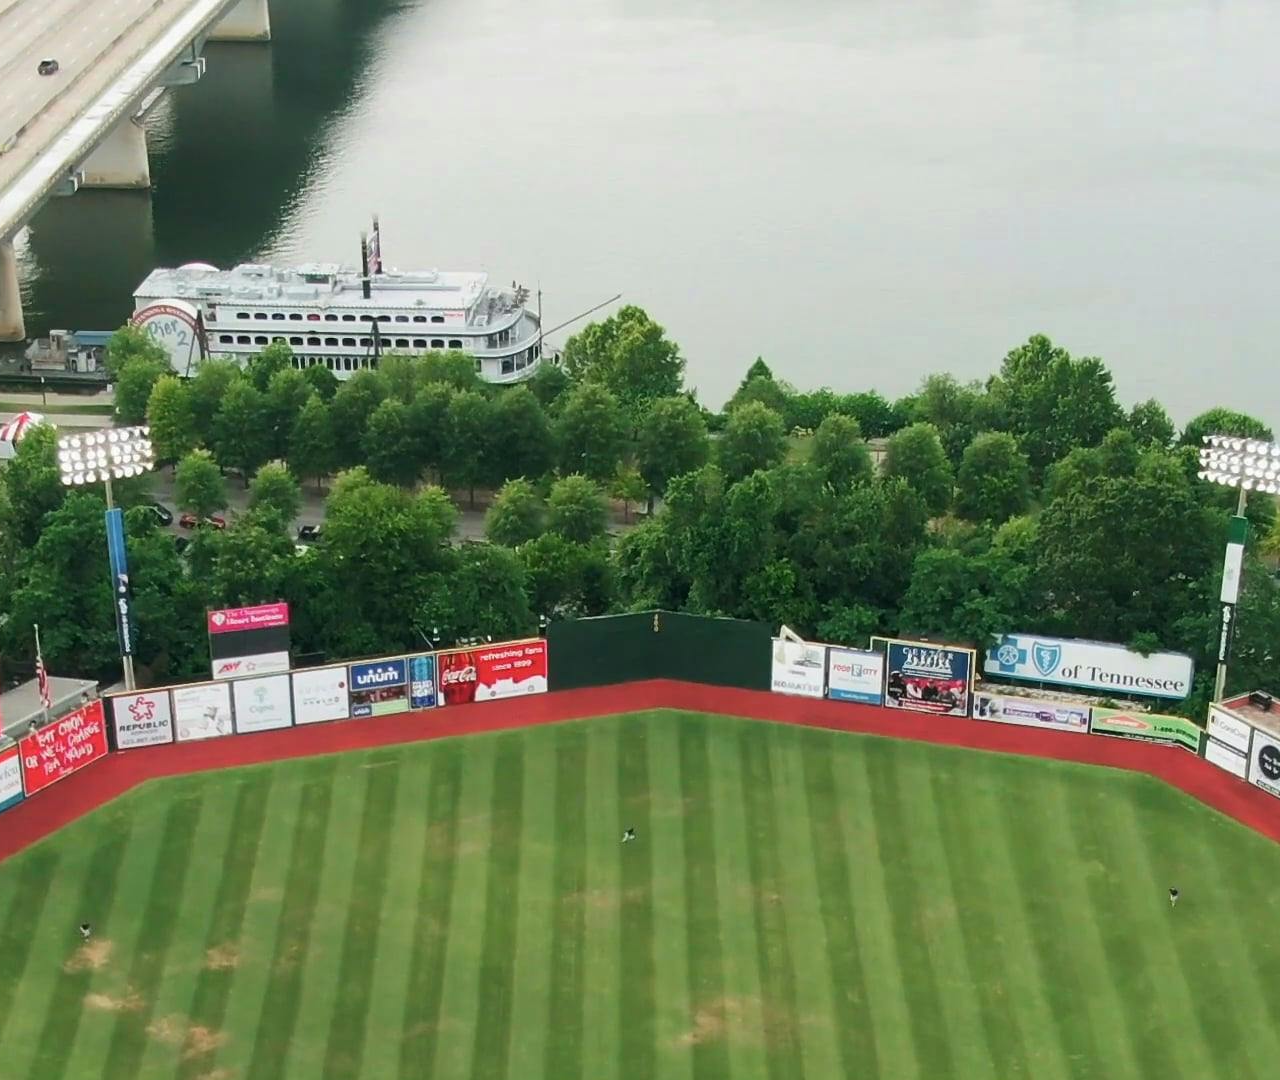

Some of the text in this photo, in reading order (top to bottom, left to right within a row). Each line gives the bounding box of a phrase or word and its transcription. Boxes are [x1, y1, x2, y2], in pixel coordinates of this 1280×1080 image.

[148, 320, 190, 346] Pier 2
[480, 646, 543, 661] refreshing fans
[357, 667, 399, 685] unum
[833, 664, 878, 676] FOOD CITY
[1061, 664, 1185, 692] of Tennessee
[119, 720, 169, 732] REPUBLIC
[37, 728, 56, 747] EAT
[25, 755, 38, 769] OR
